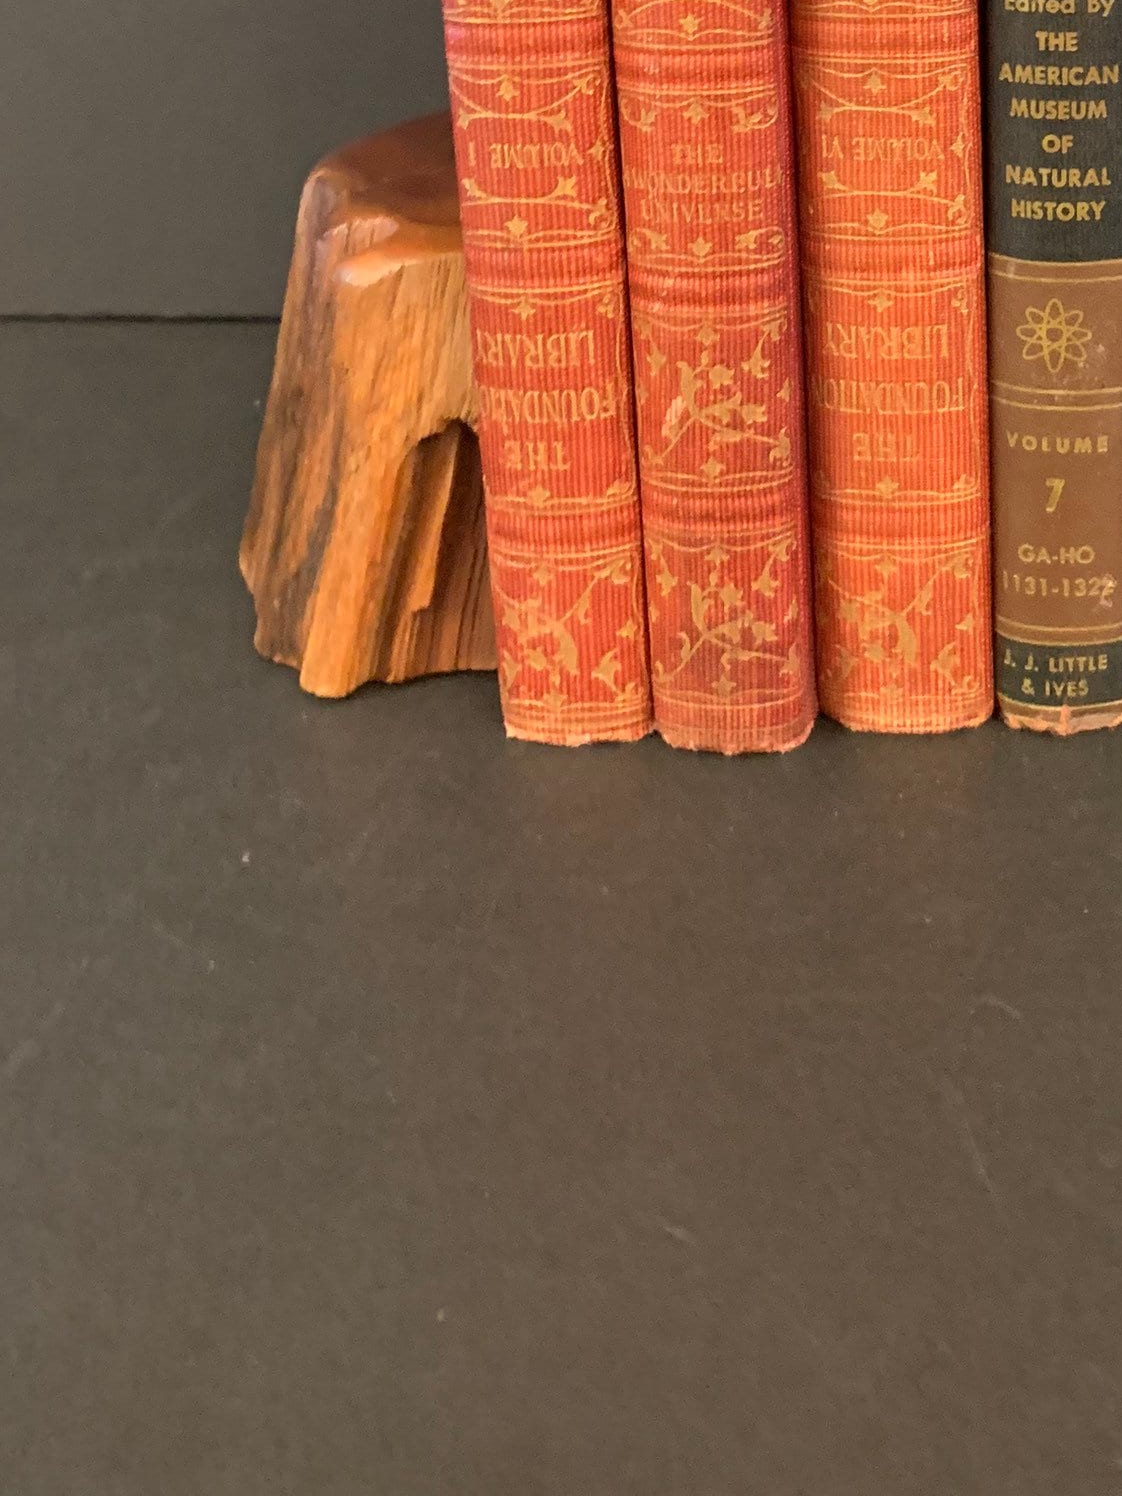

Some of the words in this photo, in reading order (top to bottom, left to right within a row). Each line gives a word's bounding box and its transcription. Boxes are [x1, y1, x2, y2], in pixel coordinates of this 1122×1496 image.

[1035, 30, 1080, 53] THE
[999, 62, 1120, 87] AMERICAN
[1009, 97, 1109, 121] MUSEUM
[488, 141, 584, 169] VOLUME
[670, 142, 724, 165] THE
[821, 134, 844, 159] VI
[853, 135, 945, 162] VOLUME
[1041, 133, 1075, 155] OF
[1005, 163, 1112, 189] NATURAL
[1010, 197, 1107, 222] HISTORY
[475, 329, 596, 369] LIBRARY
[822, 321, 949, 360] LIBRARY
[478, 382, 617, 426] FOUNDATIO
[503, 439, 571, 472] THE
[852, 432, 919, 463] THE
[1005, 431, 1110, 455] VOLUME
[1045, 477, 1066, 514] 7
[1017, 543, 1096, 565] GA-HO
[1048, 654, 1109, 673] LITTLE
[1020, 678, 1035, 695] &
[1044, 679, 1090, 698] IVES
